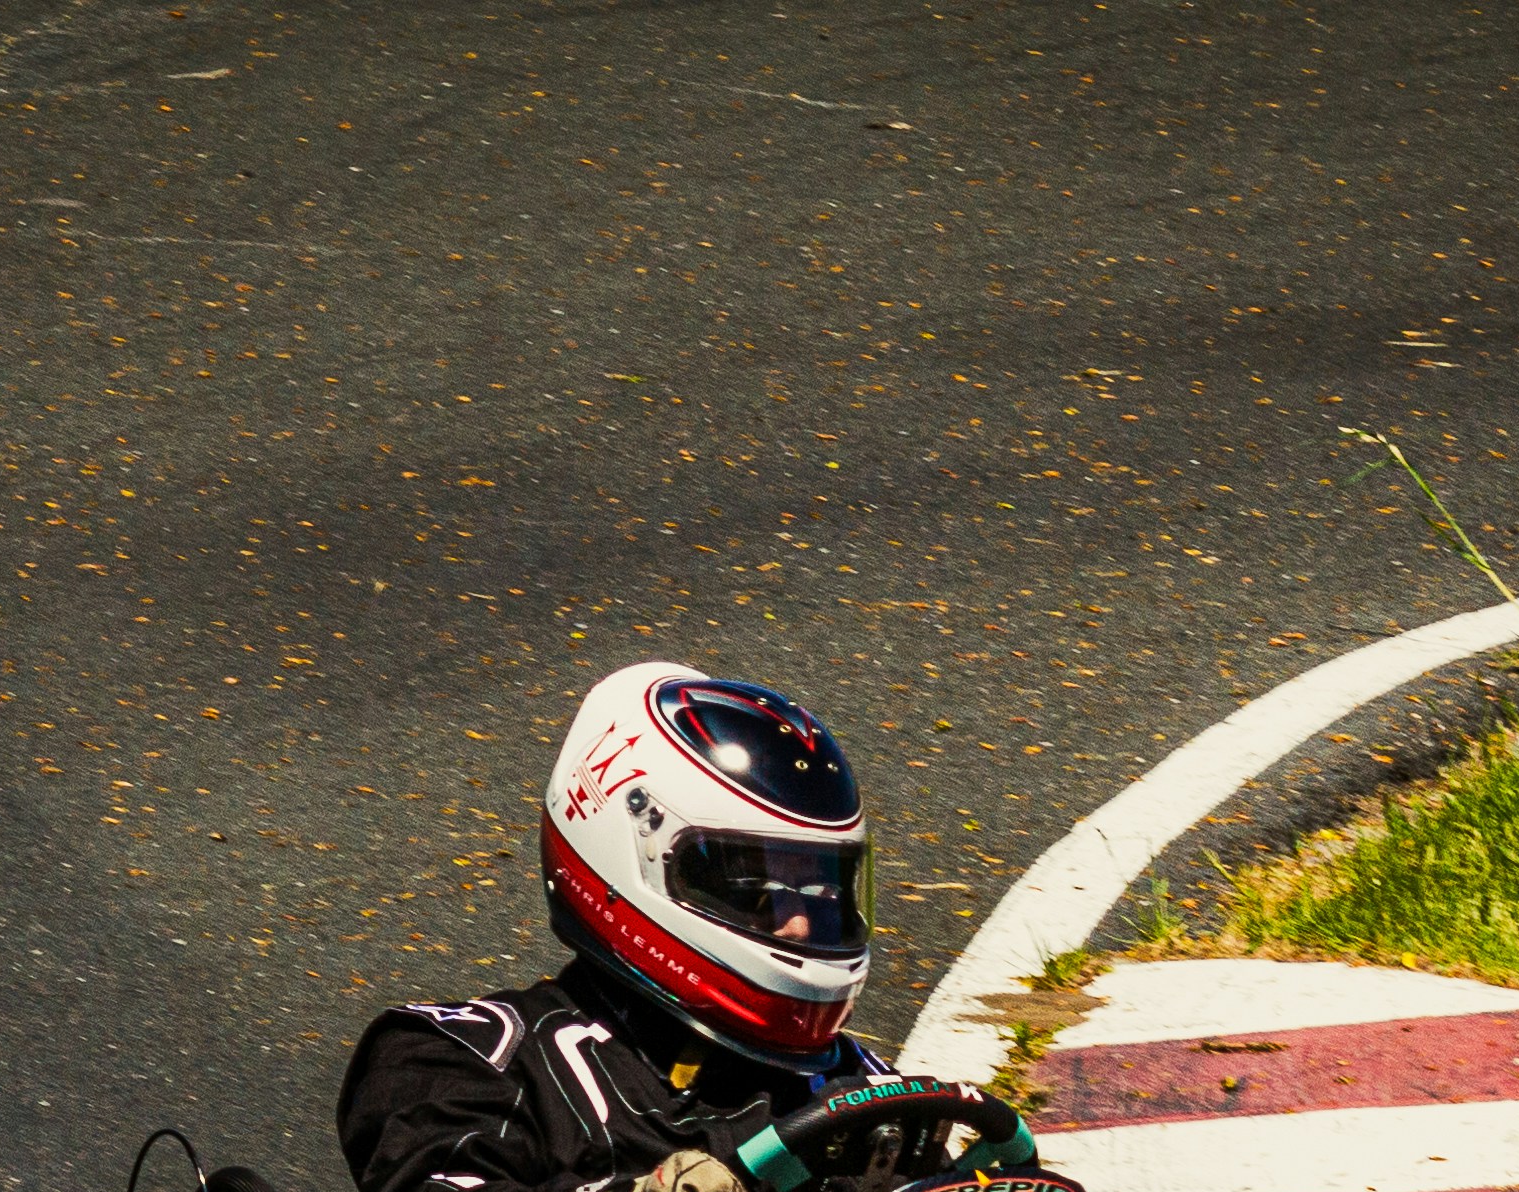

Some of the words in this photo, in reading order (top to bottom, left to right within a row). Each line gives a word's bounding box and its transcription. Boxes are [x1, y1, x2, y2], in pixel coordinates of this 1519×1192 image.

[558, 867, 615, 923] CHRIS
[620, 924, 701, 986] LEMME
[826, 1080, 952, 1113] FORMULA
[956, 1081, 985, 1103] K
